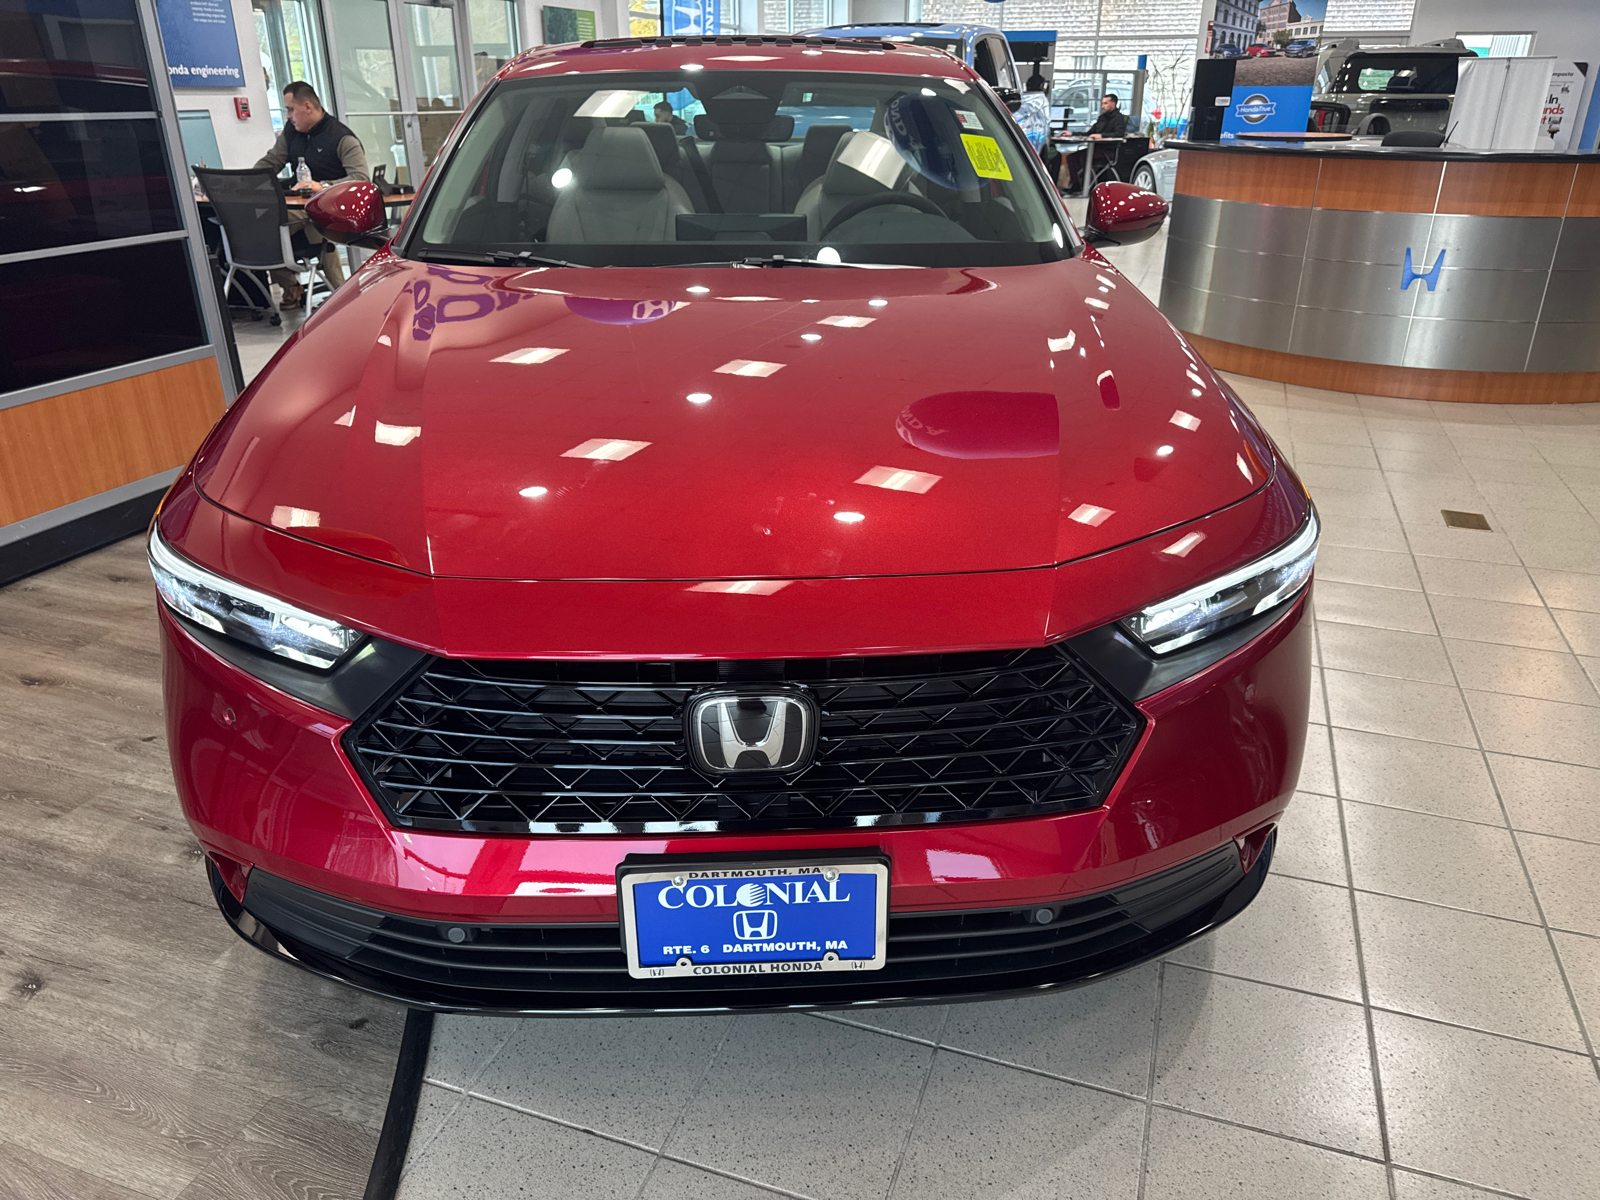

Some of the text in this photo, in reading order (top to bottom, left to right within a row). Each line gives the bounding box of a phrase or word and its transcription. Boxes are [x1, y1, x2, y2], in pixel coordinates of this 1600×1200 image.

[168, 64, 240, 78] onda engineering
[688, 867, 822, 879] DARTMOUTH, MA
[658, 880, 850, 909] COLONIAL
[663, 940, 848, 955] RTE. 6 DARTMOUTH, MA
[693, 962, 823, 975] COLONIAL HONDA
